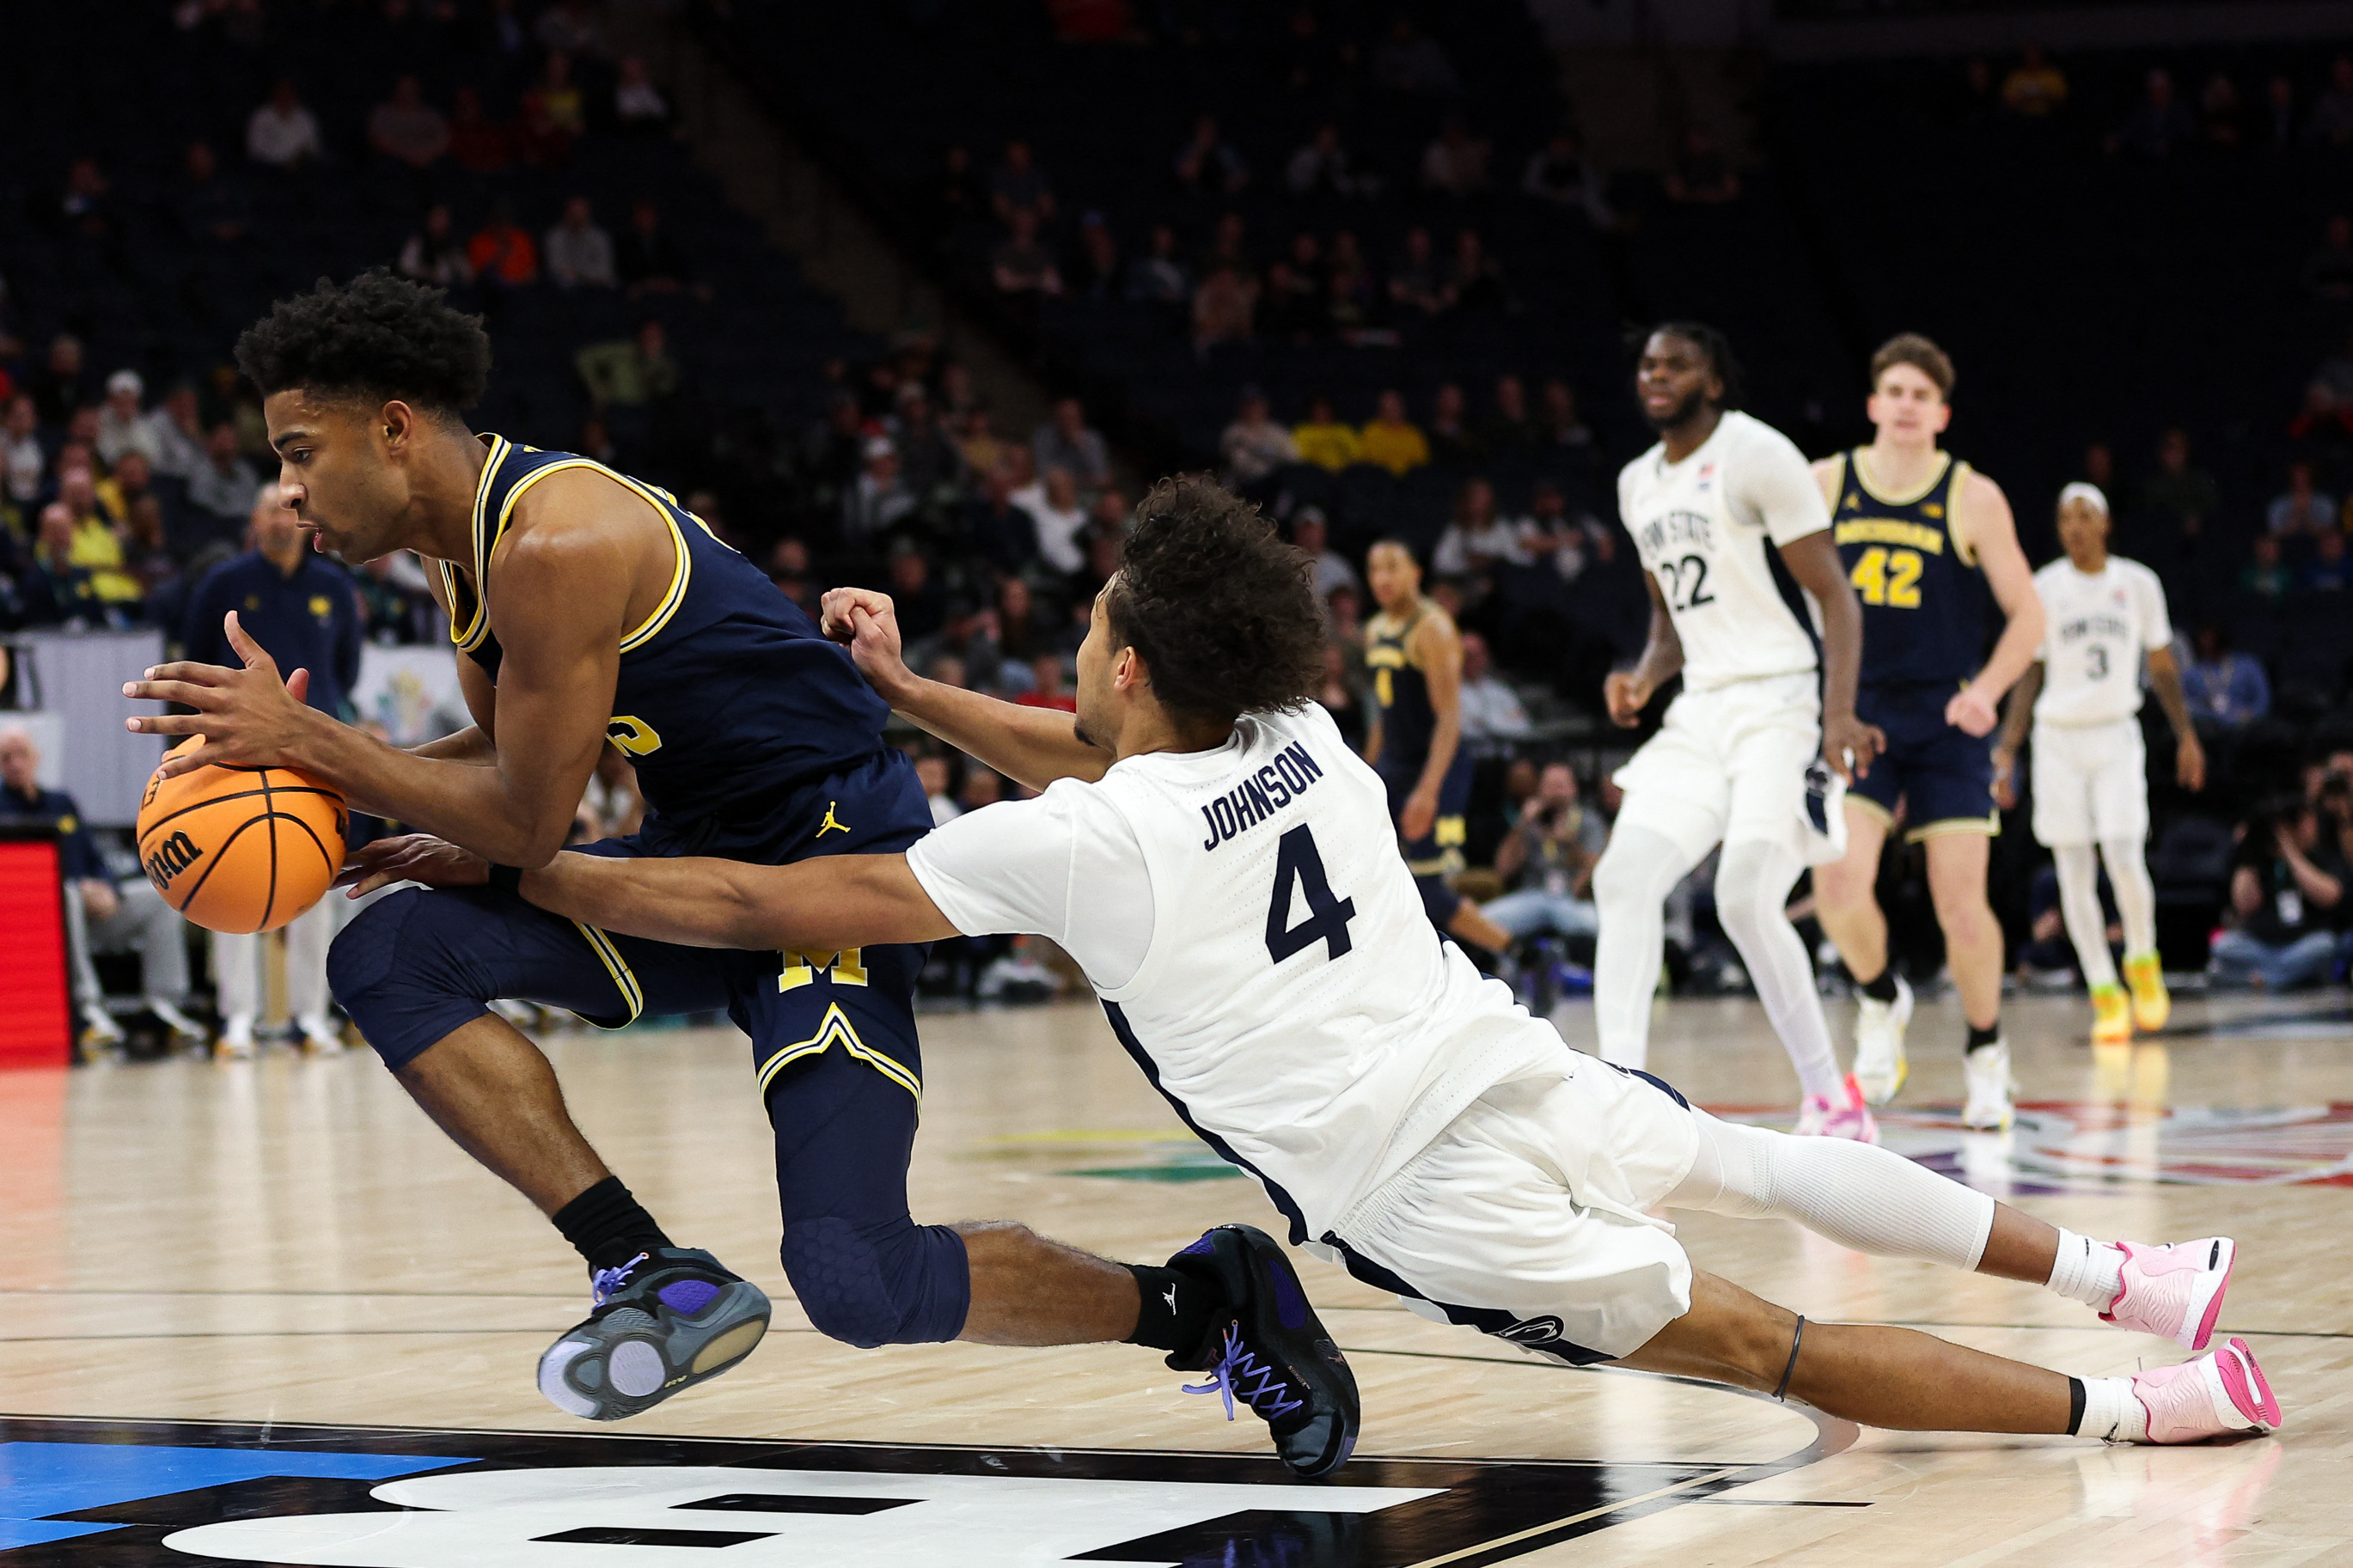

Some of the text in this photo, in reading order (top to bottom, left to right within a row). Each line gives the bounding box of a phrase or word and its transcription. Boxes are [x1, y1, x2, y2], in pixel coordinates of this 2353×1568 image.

[1851, 546, 1923, 609] 42
[2087, 645, 2108, 680] 3
[1201, 740, 1324, 852] JOHNSON
[1265, 822, 1357, 965] 4
